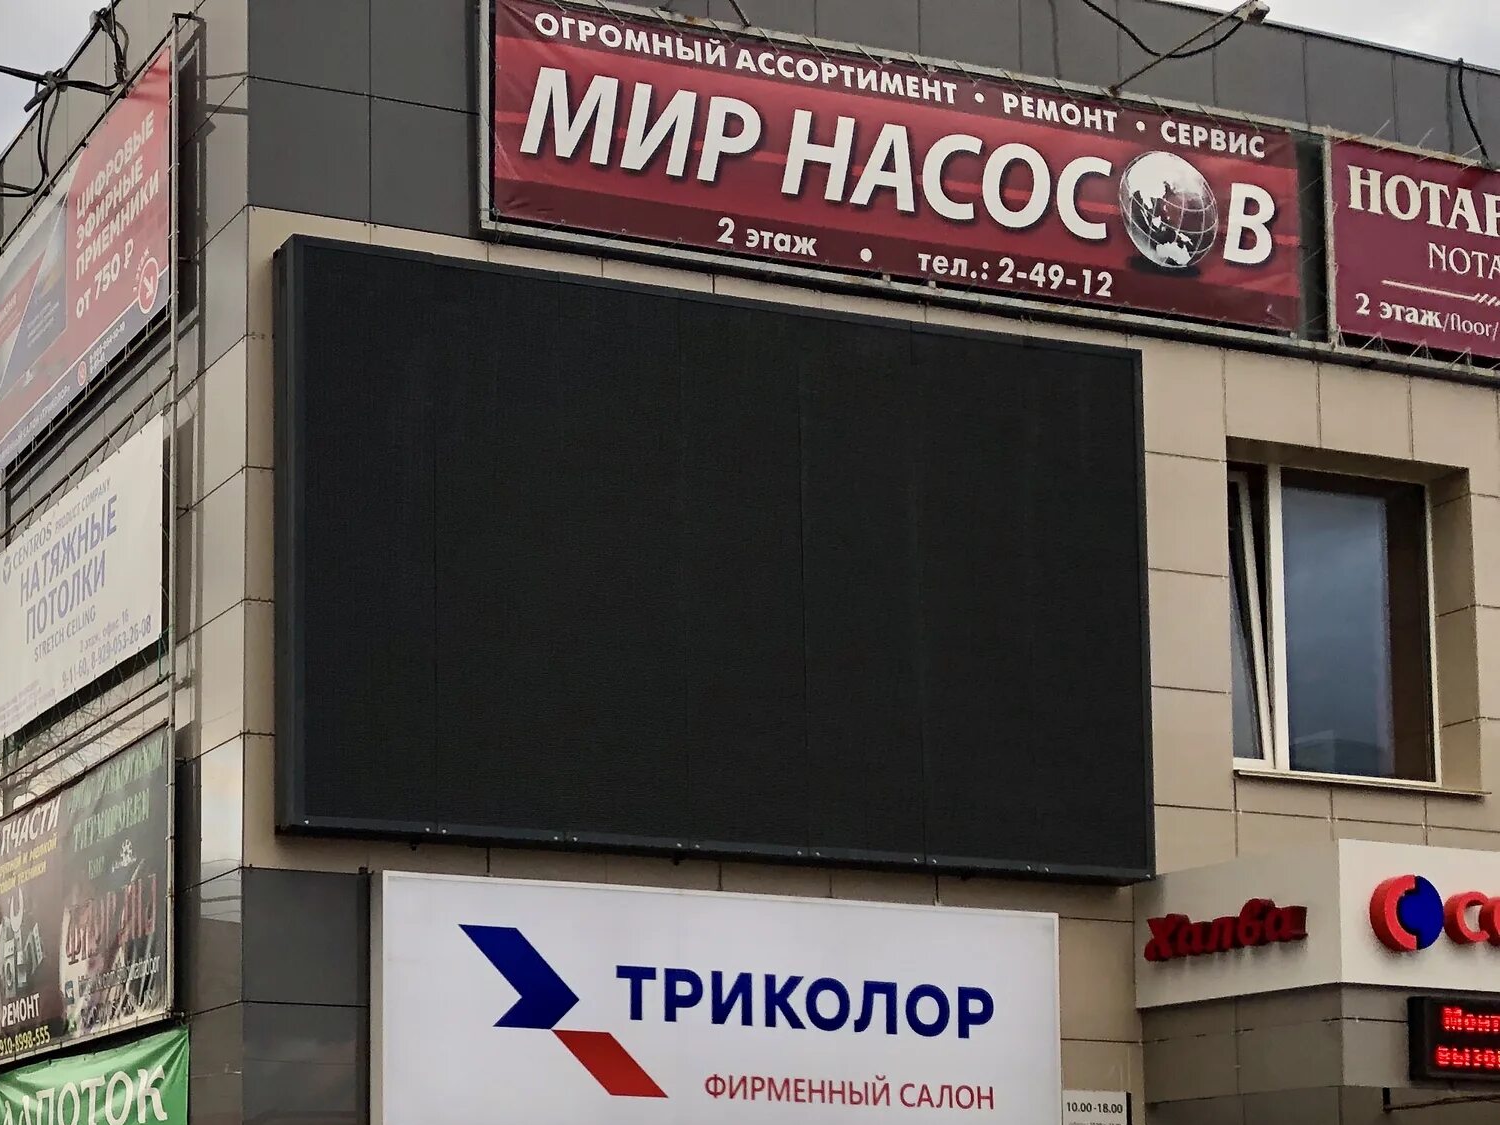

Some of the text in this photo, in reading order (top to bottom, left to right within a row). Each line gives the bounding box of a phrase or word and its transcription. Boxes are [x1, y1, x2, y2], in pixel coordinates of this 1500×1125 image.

[535, 11, 957, 106] ОГРОМНЫЙ АССОРТИМЕНТ
[521, 67, 762, 182] МИР
[1002, 91, 1266, 159] РЕМОНТ СЕРВИС
[77, 110, 154, 220] ЦИФРОВЫЕ
[76, 169, 159, 281] ПРИЕМНИКИ
[77, 155, 144, 249] ЭФИРНЫЕ
[717, 217, 818, 259] 2 этаж
[95, 253, 120, 300] 750
[917, 248, 1113, 298] тел.: 2-49-12
[1355, 293, 1370, 315] 2
[12, 521, 52, 569] CENTROS
[20, 494, 118, 607] НАТЯЖНЫЕ
[26, 550, 106, 644] ПОТОЛКИ
[34, 605, 96, 663] STRETCH CEILING
[1144, 898, 1308, 963] Халва
[1, 993, 40, 1028] РЕМОНТ
[616, 965, 994, 1038] ТРИКОЛОР
[704, 1073, 995, 1110] ФИРМЕННЫЙ САЛОН
